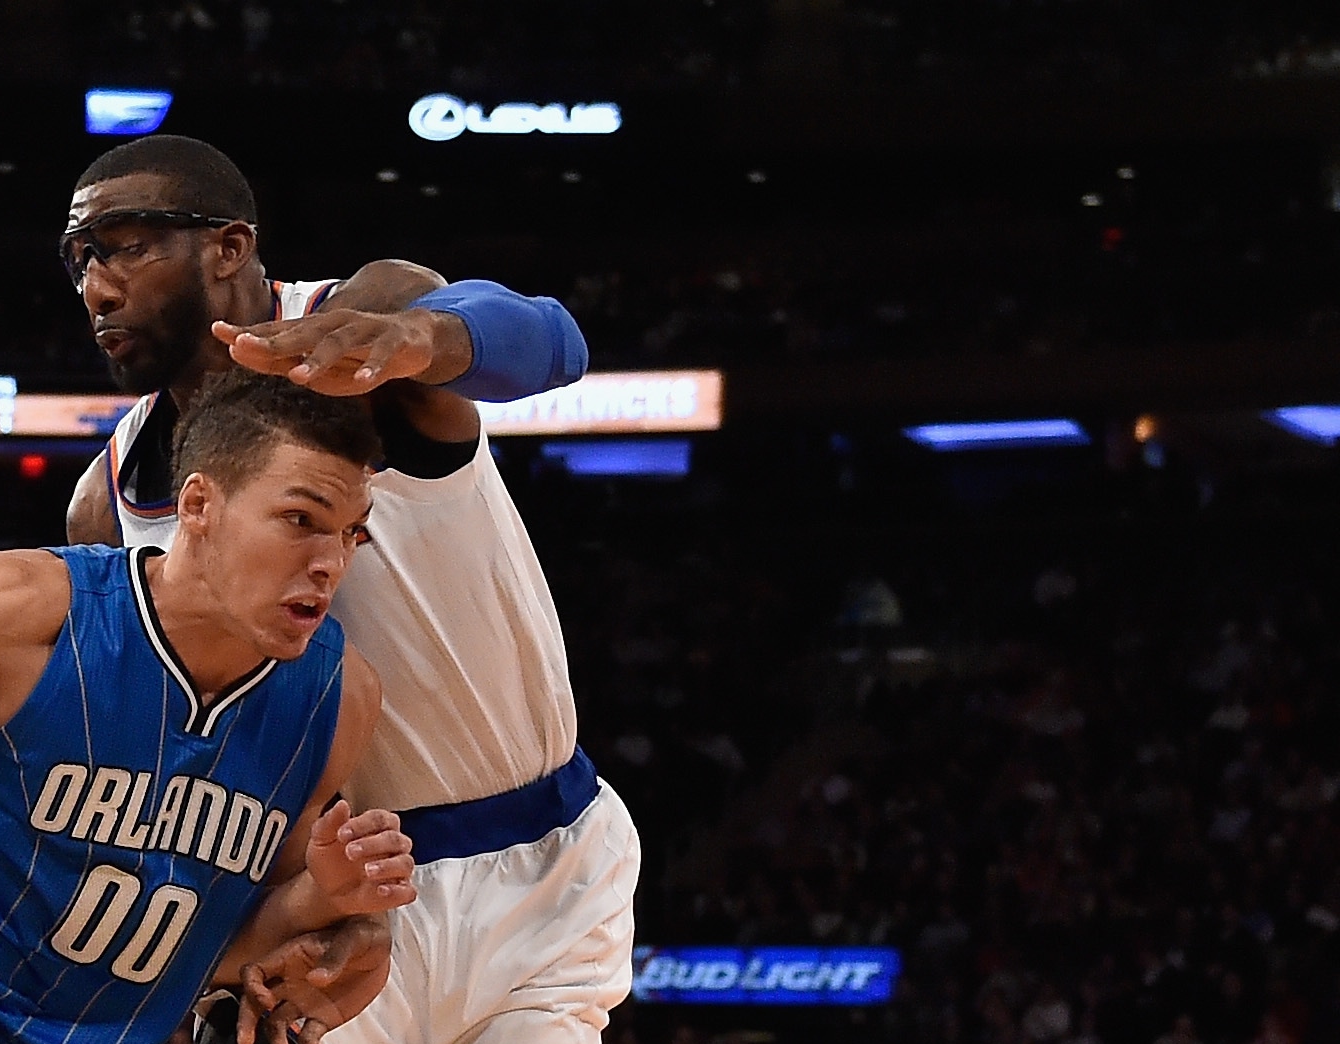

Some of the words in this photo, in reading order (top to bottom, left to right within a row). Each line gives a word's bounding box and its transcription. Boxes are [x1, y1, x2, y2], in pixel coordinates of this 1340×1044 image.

[29, 763, 289, 884] ORLANDO
[50, 864, 199, 984] 00
[634, 955, 739, 991] BUD
[740, 958, 882, 992] LIGHT
